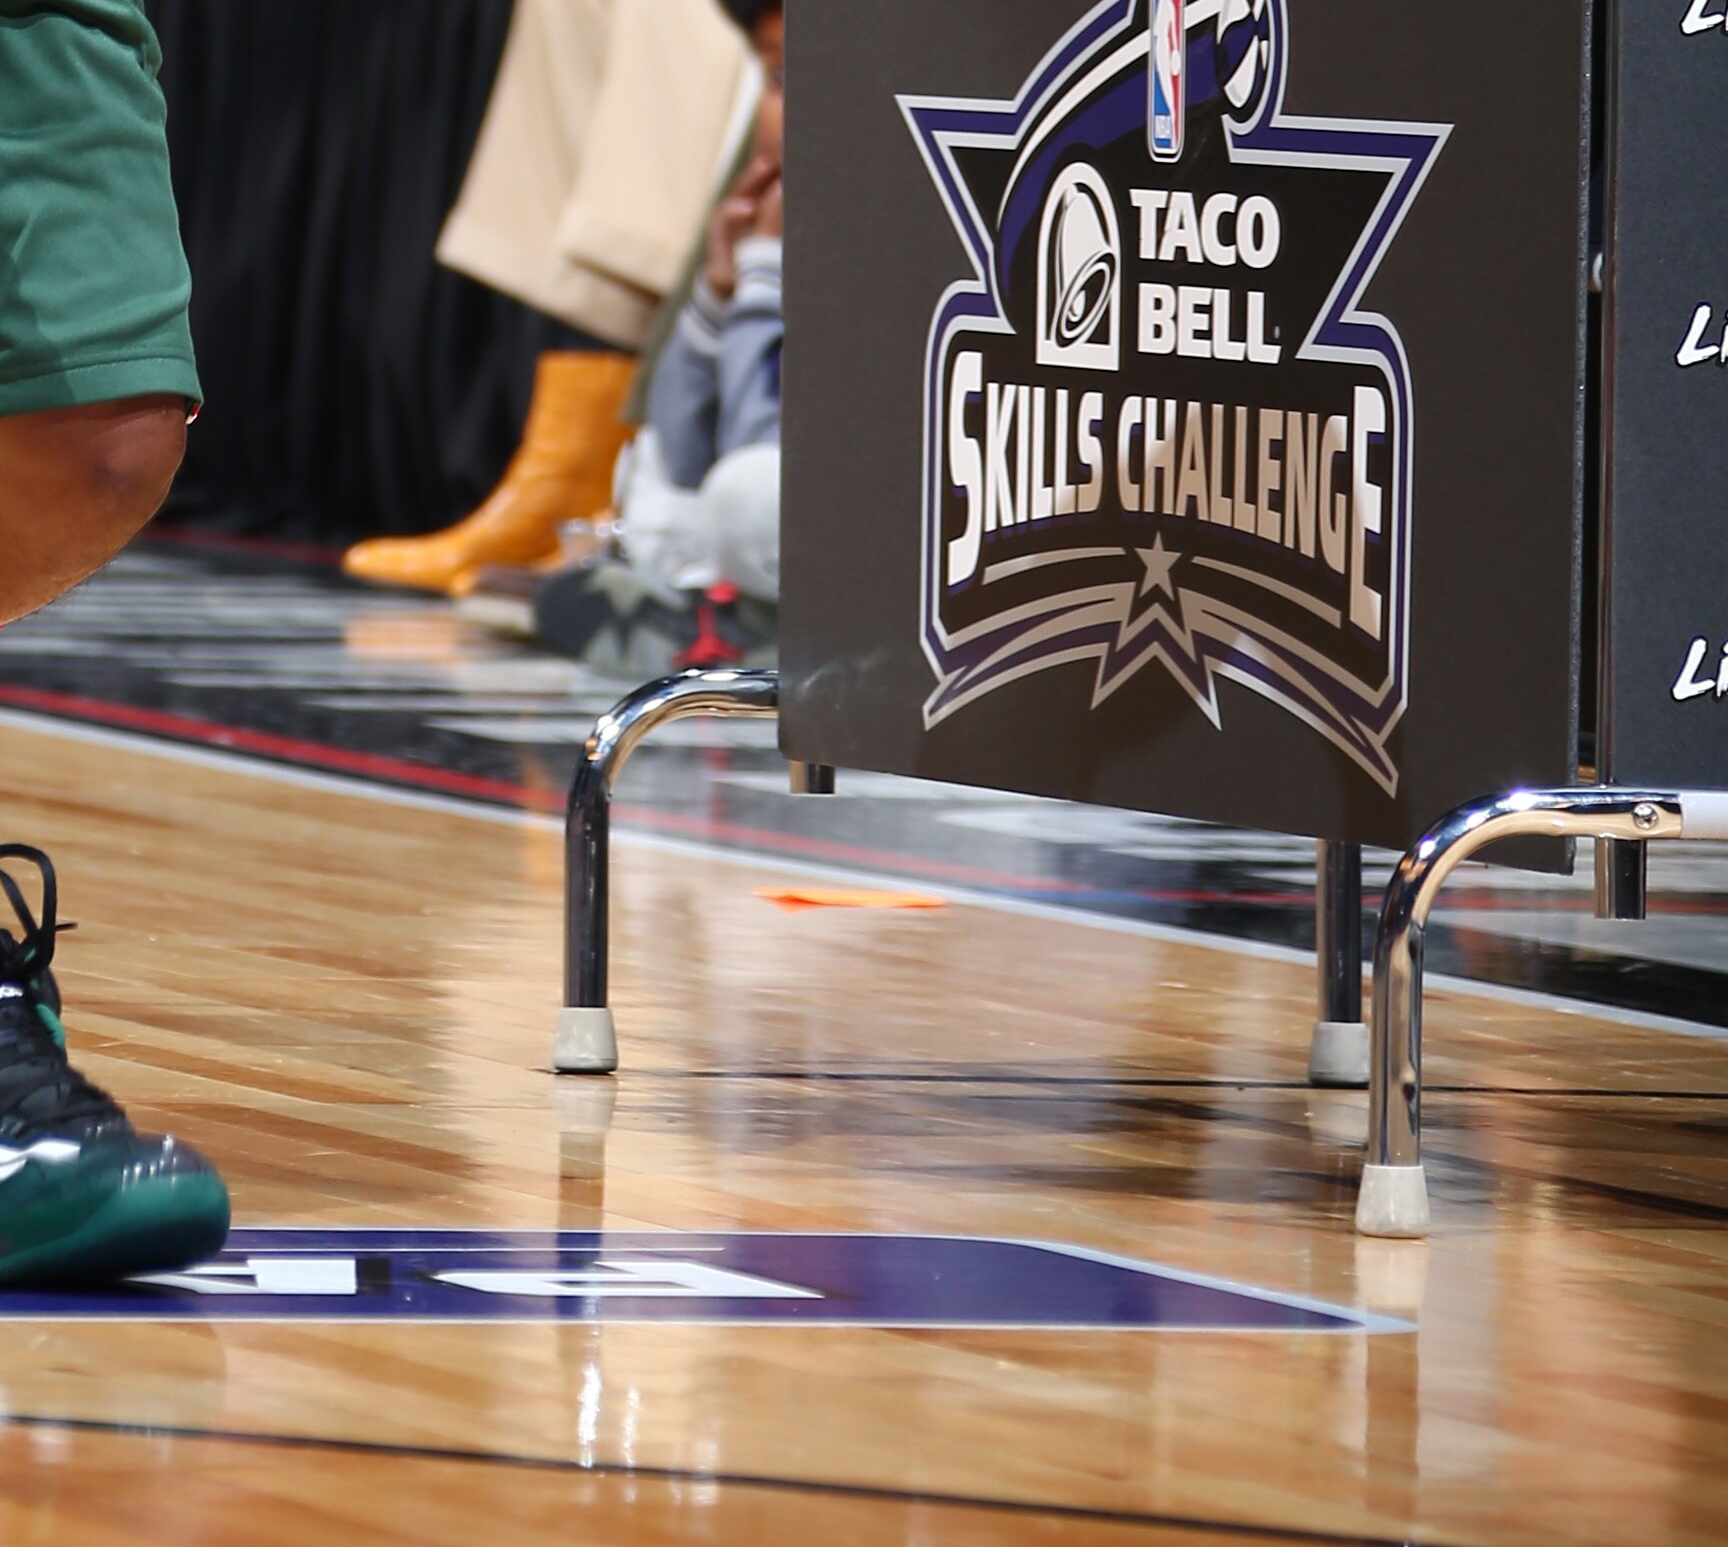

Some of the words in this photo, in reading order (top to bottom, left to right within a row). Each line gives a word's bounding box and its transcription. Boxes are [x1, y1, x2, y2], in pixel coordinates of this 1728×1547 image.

[1130, 188, 1281, 269] TACO
[1137, 284, 1281, 363] BELL
[947, 351, 1103, 587] SKILLS
[1117, 385, 1387, 641] CHALLENGE
